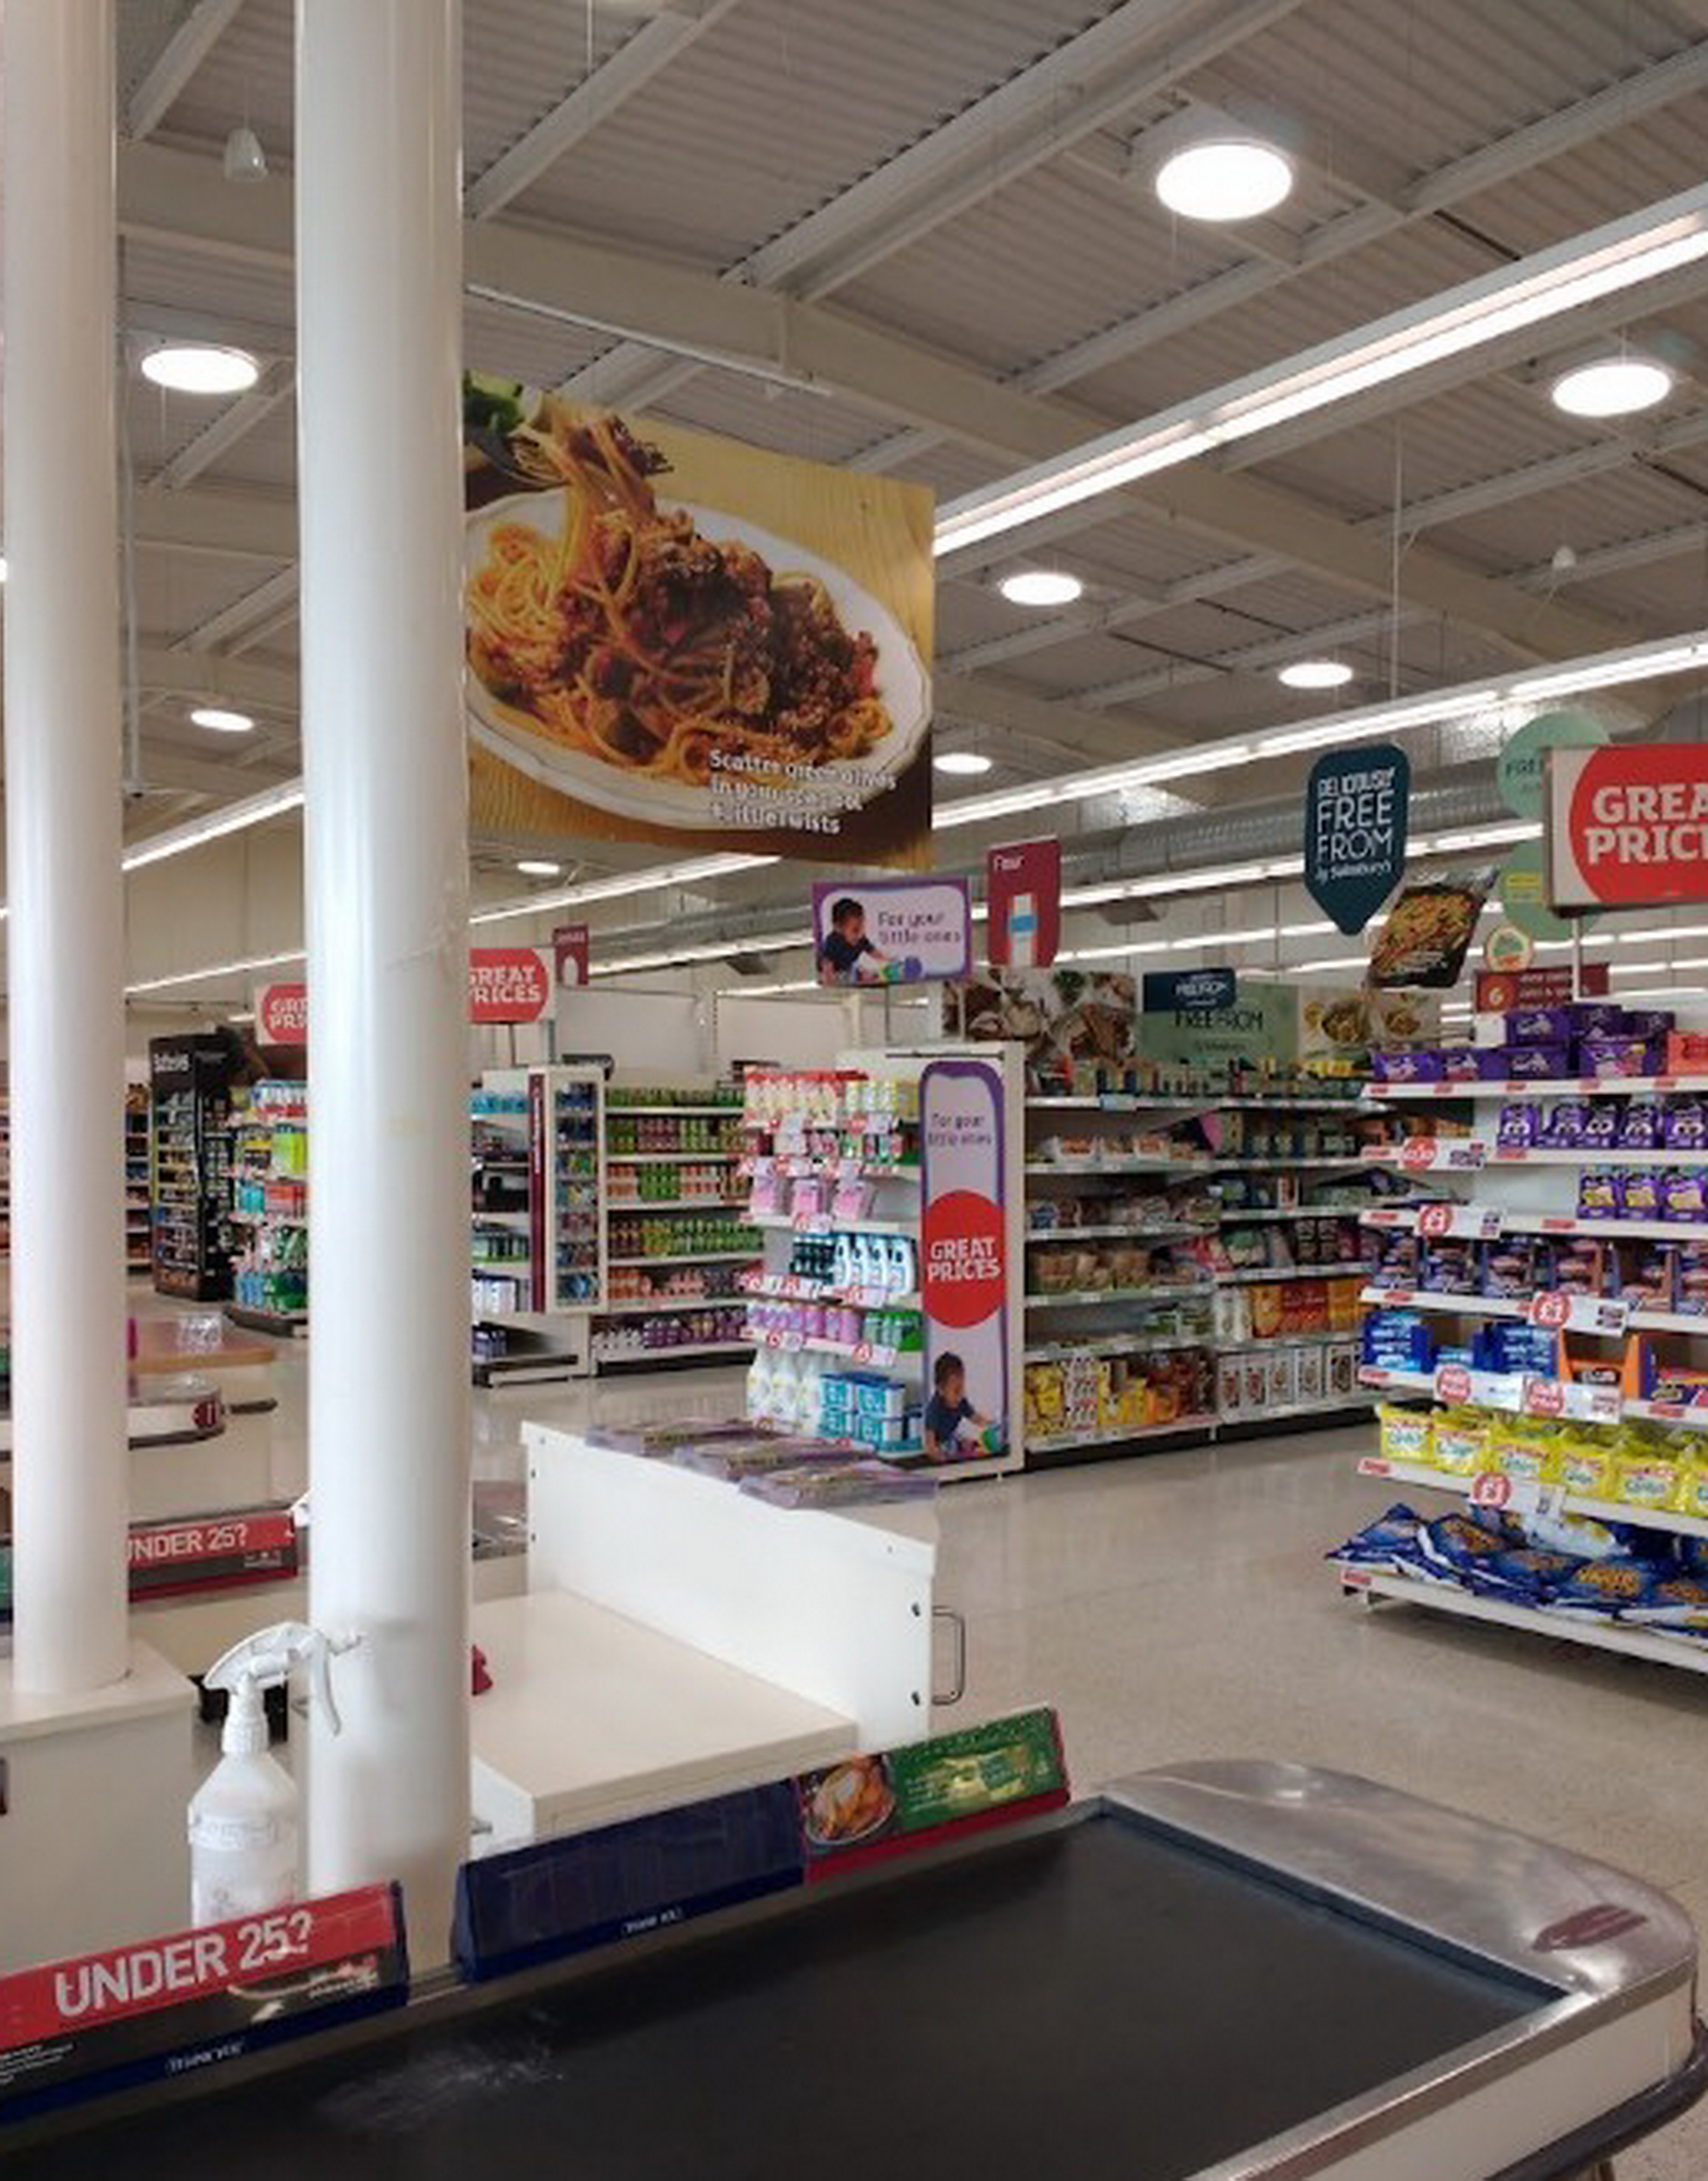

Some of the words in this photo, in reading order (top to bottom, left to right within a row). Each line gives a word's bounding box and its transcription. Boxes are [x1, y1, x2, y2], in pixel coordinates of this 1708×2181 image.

[1317, 790, 1395, 834] FREE
[1592, 782, 1708, 824] GREA
[1317, 827, 1394, 862] FROM
[469, 984, 542, 1003] RICES
[930, 1236, 997, 1261] GREAT
[928, 1257, 1001, 1283] PRICES
[207, 1523, 249, 1552] 25?
[54, 1933, 229, 2018] UNDER
[236, 1909, 313, 1972] 25?
